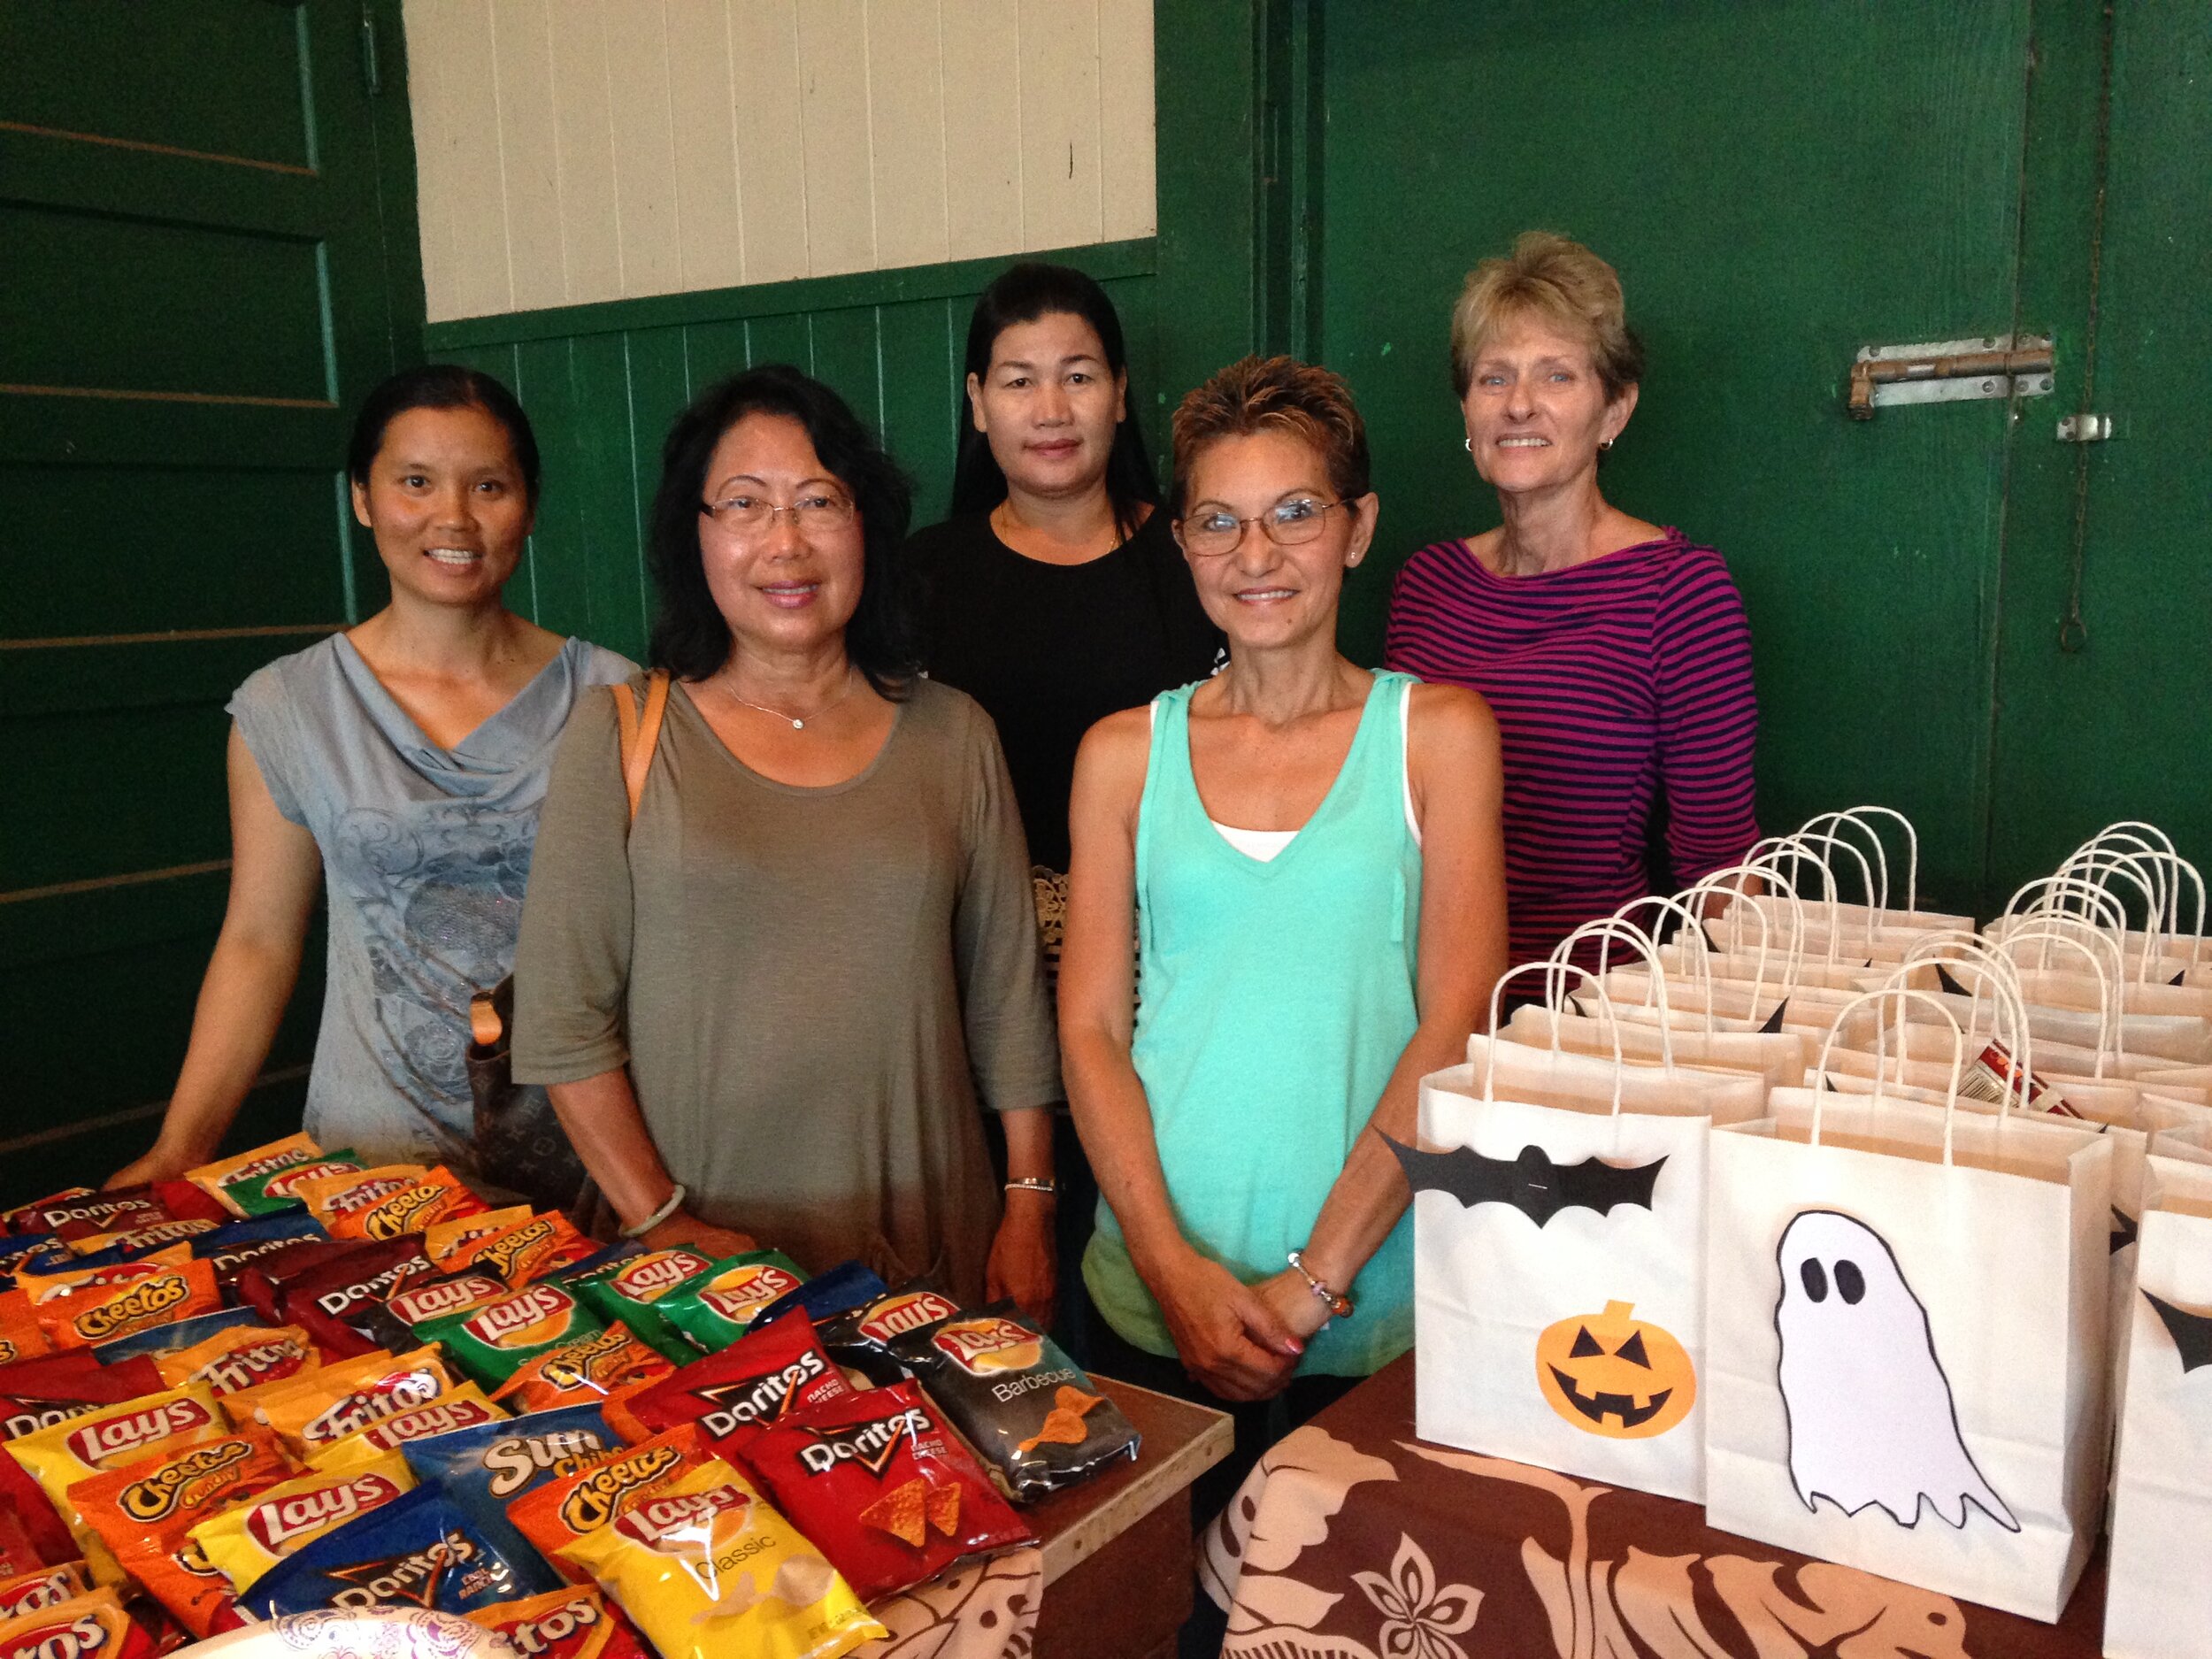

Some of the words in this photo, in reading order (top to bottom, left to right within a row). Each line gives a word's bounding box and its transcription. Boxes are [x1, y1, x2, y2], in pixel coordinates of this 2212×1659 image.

[43, 1199, 151, 1227] Doritos
[318, 1256, 431, 1315] Doritos
[399, 1279, 493, 1322] Lay's
[618, 1255, 697, 1295] Lay's
[708, 1270, 788, 1313] Lay's
[74, 1277, 185, 1335] Cheetos
[476, 1286, 559, 1340] Lay's
[942, 1324, 1023, 1361] Lay's
[701, 1350, 824, 1438] Doritos
[991, 1367, 1077, 1403] Barbecue
[80, 1401, 196, 1461] Lay's
[800, 1408, 930, 1472] Doritos
[484, 1430, 602, 1497] Sun
[260, 1477, 384, 1546] Lay's
[331, 1532, 474, 1609] Doritos
[695, 1534, 777, 1579] Classic
